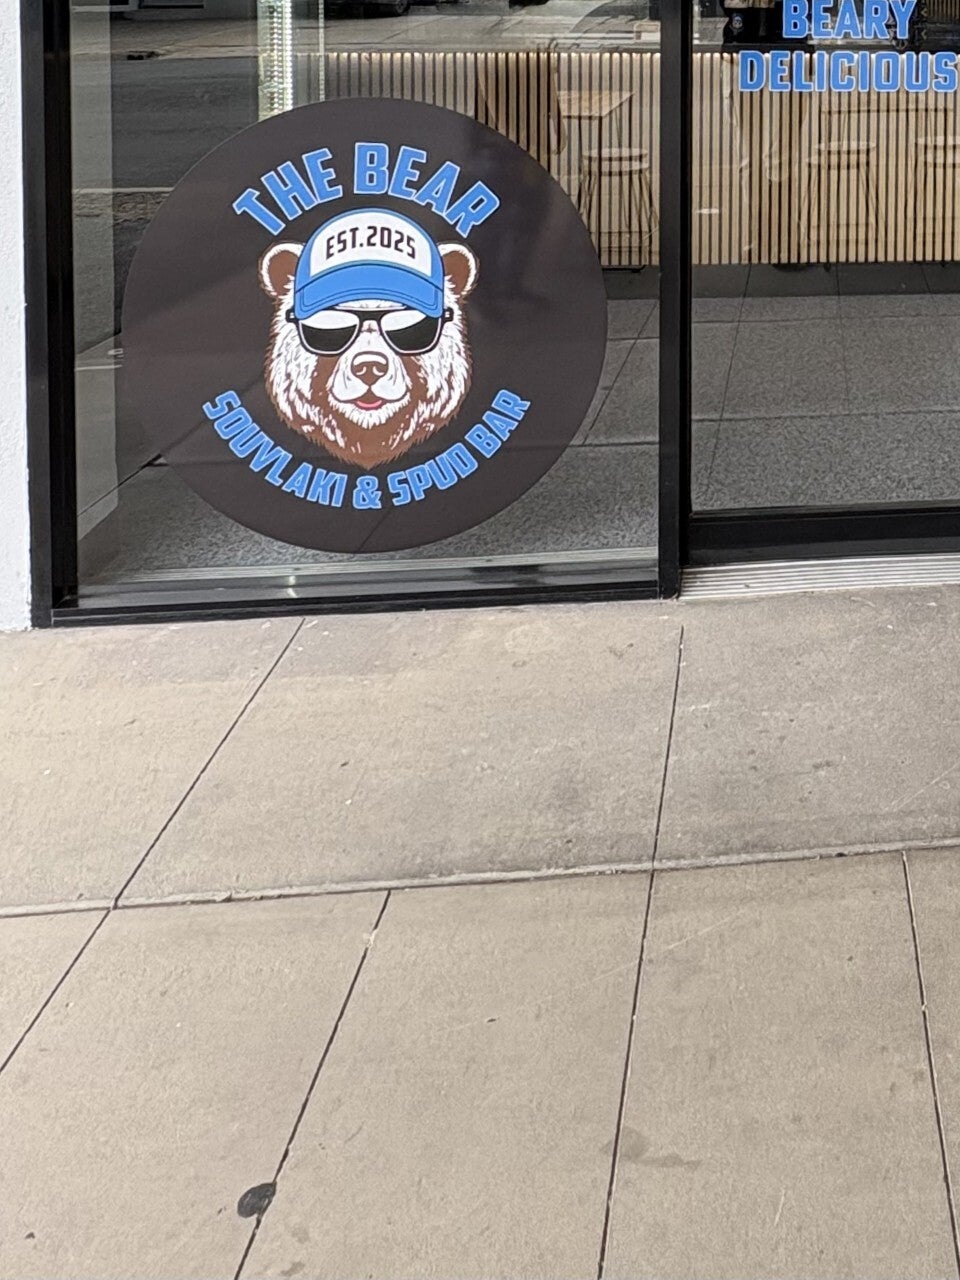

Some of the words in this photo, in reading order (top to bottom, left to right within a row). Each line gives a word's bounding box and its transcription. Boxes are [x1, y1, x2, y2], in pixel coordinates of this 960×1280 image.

[738, 50, 959, 93] DELICIOUS
[232, 147, 343, 236] THE
[354, 142, 501, 238] BEAR
[325, 225, 417, 260] EST.2025
[202, 390, 348, 508] SOUVLAKI
[352, 474, 382, 509] &
[387, 441, 479, 506] SPUD
[465, 388, 531, 458] BAR
